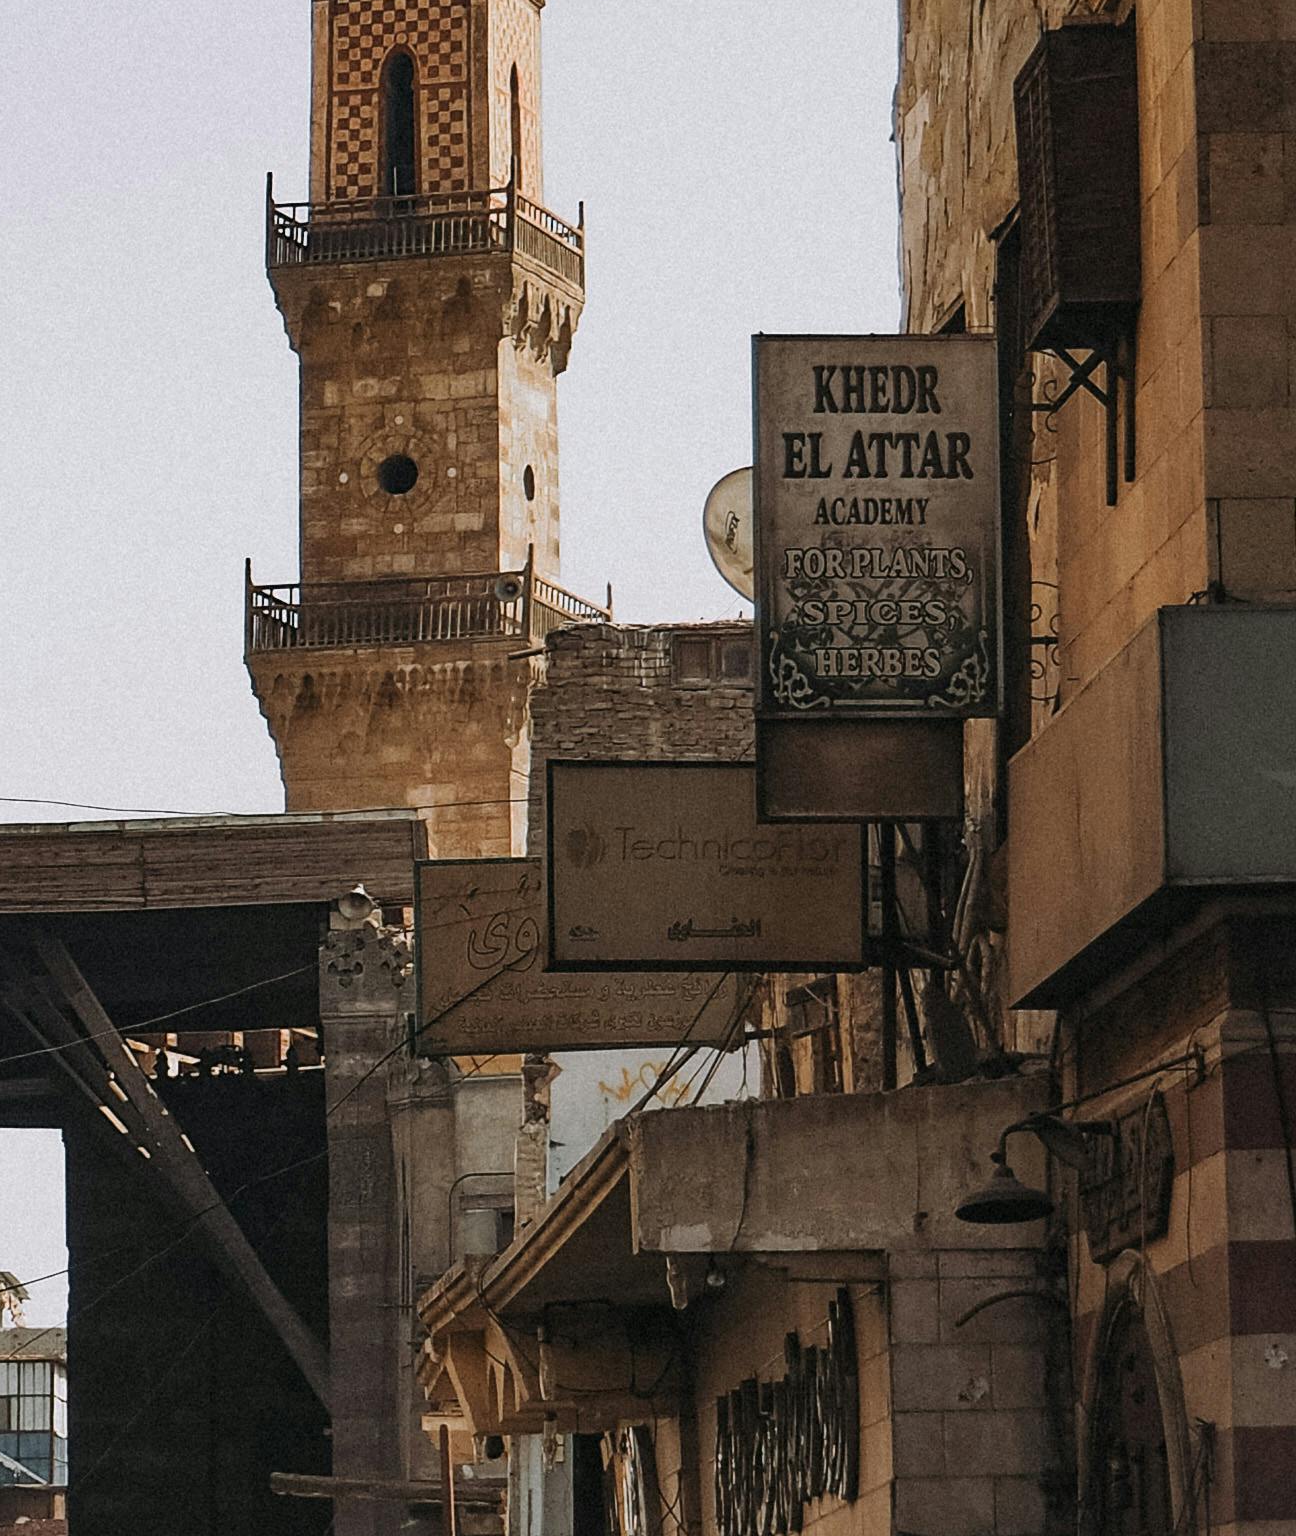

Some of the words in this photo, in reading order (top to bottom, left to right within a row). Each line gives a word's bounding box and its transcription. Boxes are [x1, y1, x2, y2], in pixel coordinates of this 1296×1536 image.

[812, 364, 942, 415] KHEDR
[782, 432, 833, 479] EL
[842, 429, 974, 480] ATTAR
[813, 496, 930, 526] ACADEMY
[784, 547, 852, 580] FOR
[853, 547, 974, 585] PLANTS,
[802, 599, 956, 631] SPICES,
[814, 647, 942, 679] HERBES
